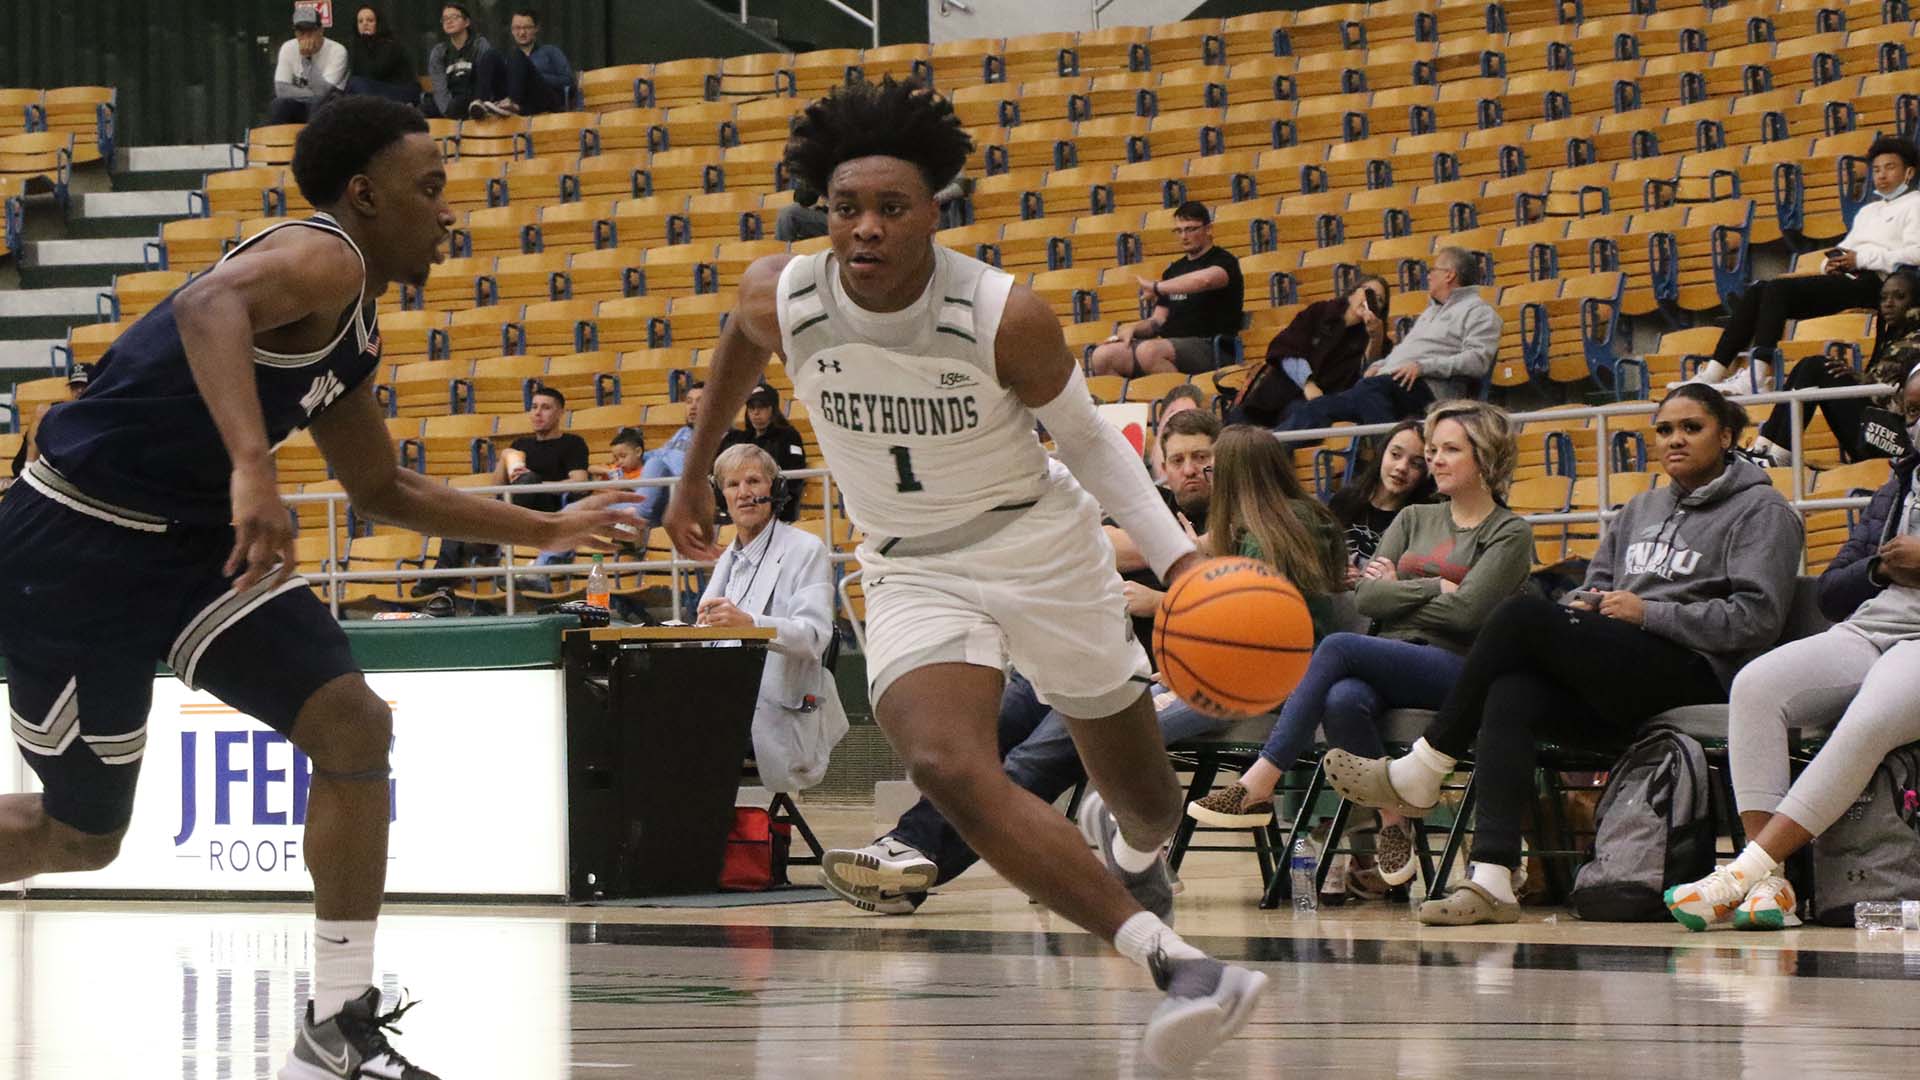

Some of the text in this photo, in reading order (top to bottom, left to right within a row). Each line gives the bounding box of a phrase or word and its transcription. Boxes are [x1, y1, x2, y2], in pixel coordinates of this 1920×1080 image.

[820, 390, 979, 436] GREYHOUNDS
[1864, 431, 1905, 456] MADDEN
[1866, 421, 1899, 444] STEVE
[888, 445, 924, 493] 1
[214, 730, 397, 825] FE
[209, 840, 307, 871] ROOF
